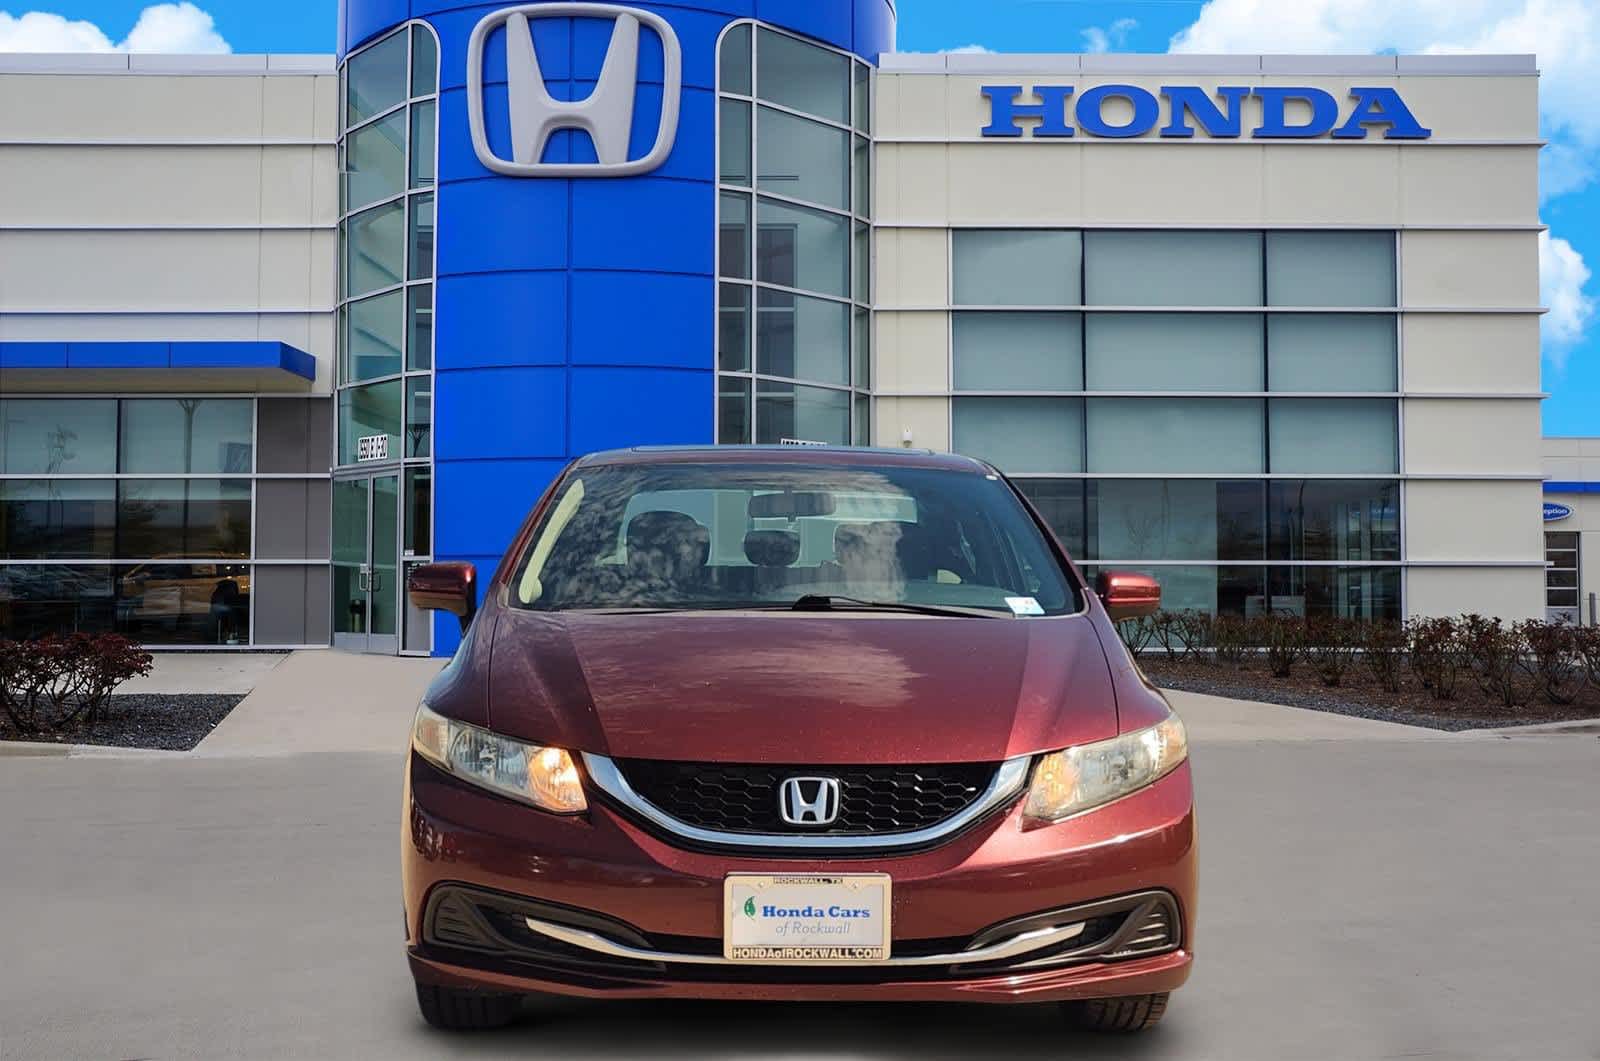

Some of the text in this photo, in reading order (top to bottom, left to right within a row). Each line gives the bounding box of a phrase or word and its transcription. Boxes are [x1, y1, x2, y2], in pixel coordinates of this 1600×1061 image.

[981, 85, 1432, 139] HONDA
[762, 906, 870, 917] Honda Cars
[775, 921, 850, 936] of Rockwall
